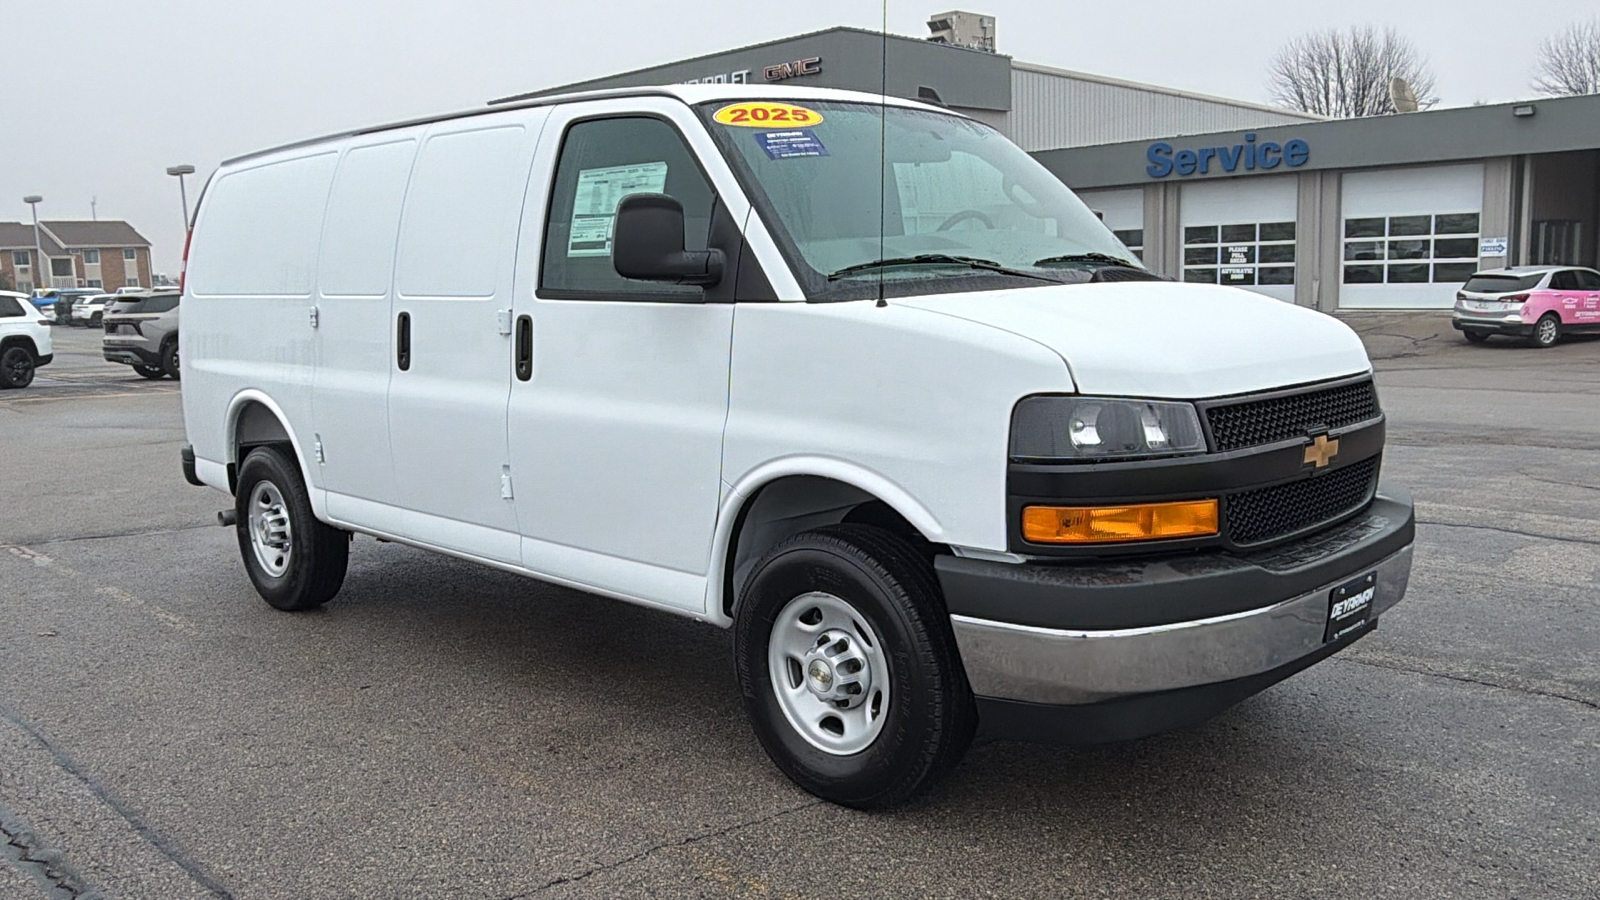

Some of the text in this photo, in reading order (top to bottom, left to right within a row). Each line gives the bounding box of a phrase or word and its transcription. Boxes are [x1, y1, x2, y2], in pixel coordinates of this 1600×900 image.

[764, 56, 820, 81] GMC
[729, 108, 810, 123] 2025
[1146, 133, 1309, 178] Service
[1330, 586, 1375, 619] DEYARMAN
